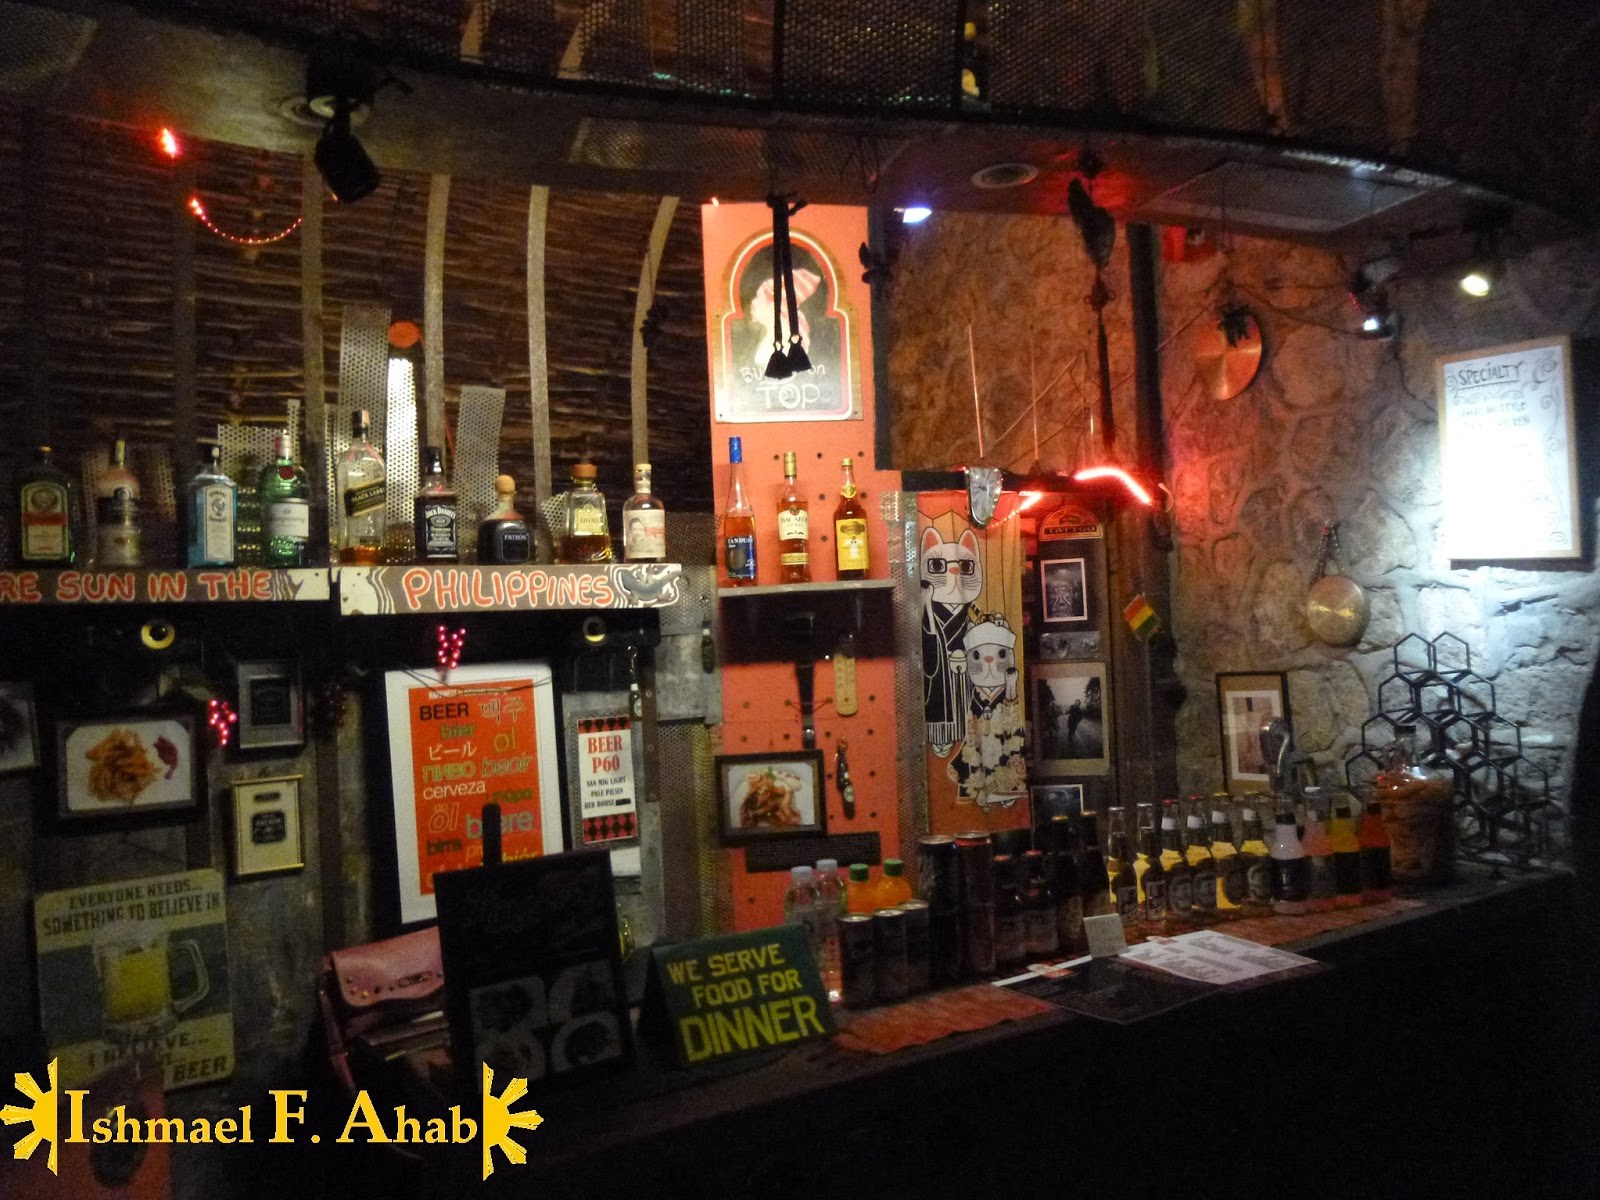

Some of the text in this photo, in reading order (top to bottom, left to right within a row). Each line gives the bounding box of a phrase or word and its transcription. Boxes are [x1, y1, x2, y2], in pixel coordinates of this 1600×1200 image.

[1458, 360, 1524, 387] SPECIALTY
[756, 382, 820, 409] TOP
[56, 571, 136, 602] SUN
[149, 571, 188, 601] IN
[197, 569, 273, 600] THE
[402, 568, 615, 610] PHILIPPINES
[419, 702, 469, 721] BEER
[441, 723, 476, 739] bier
[428, 741, 477, 761] ビール
[587, 735, 623, 754] BEER
[592, 755, 620, 774] P60
[423, 780, 486, 800] cerveza
[610, 776, 626, 785] LIGHT
[69, 885, 143, 910] EVERYONE
[42, 892, 220, 936] SOMETHING TO BELIEVE IN
[667, 943, 786, 984] WE SERVE
[691, 968, 803, 1008] FOOD FOR
[679, 995, 826, 1062] DINNER
[173, 1056, 227, 1083] BEER
